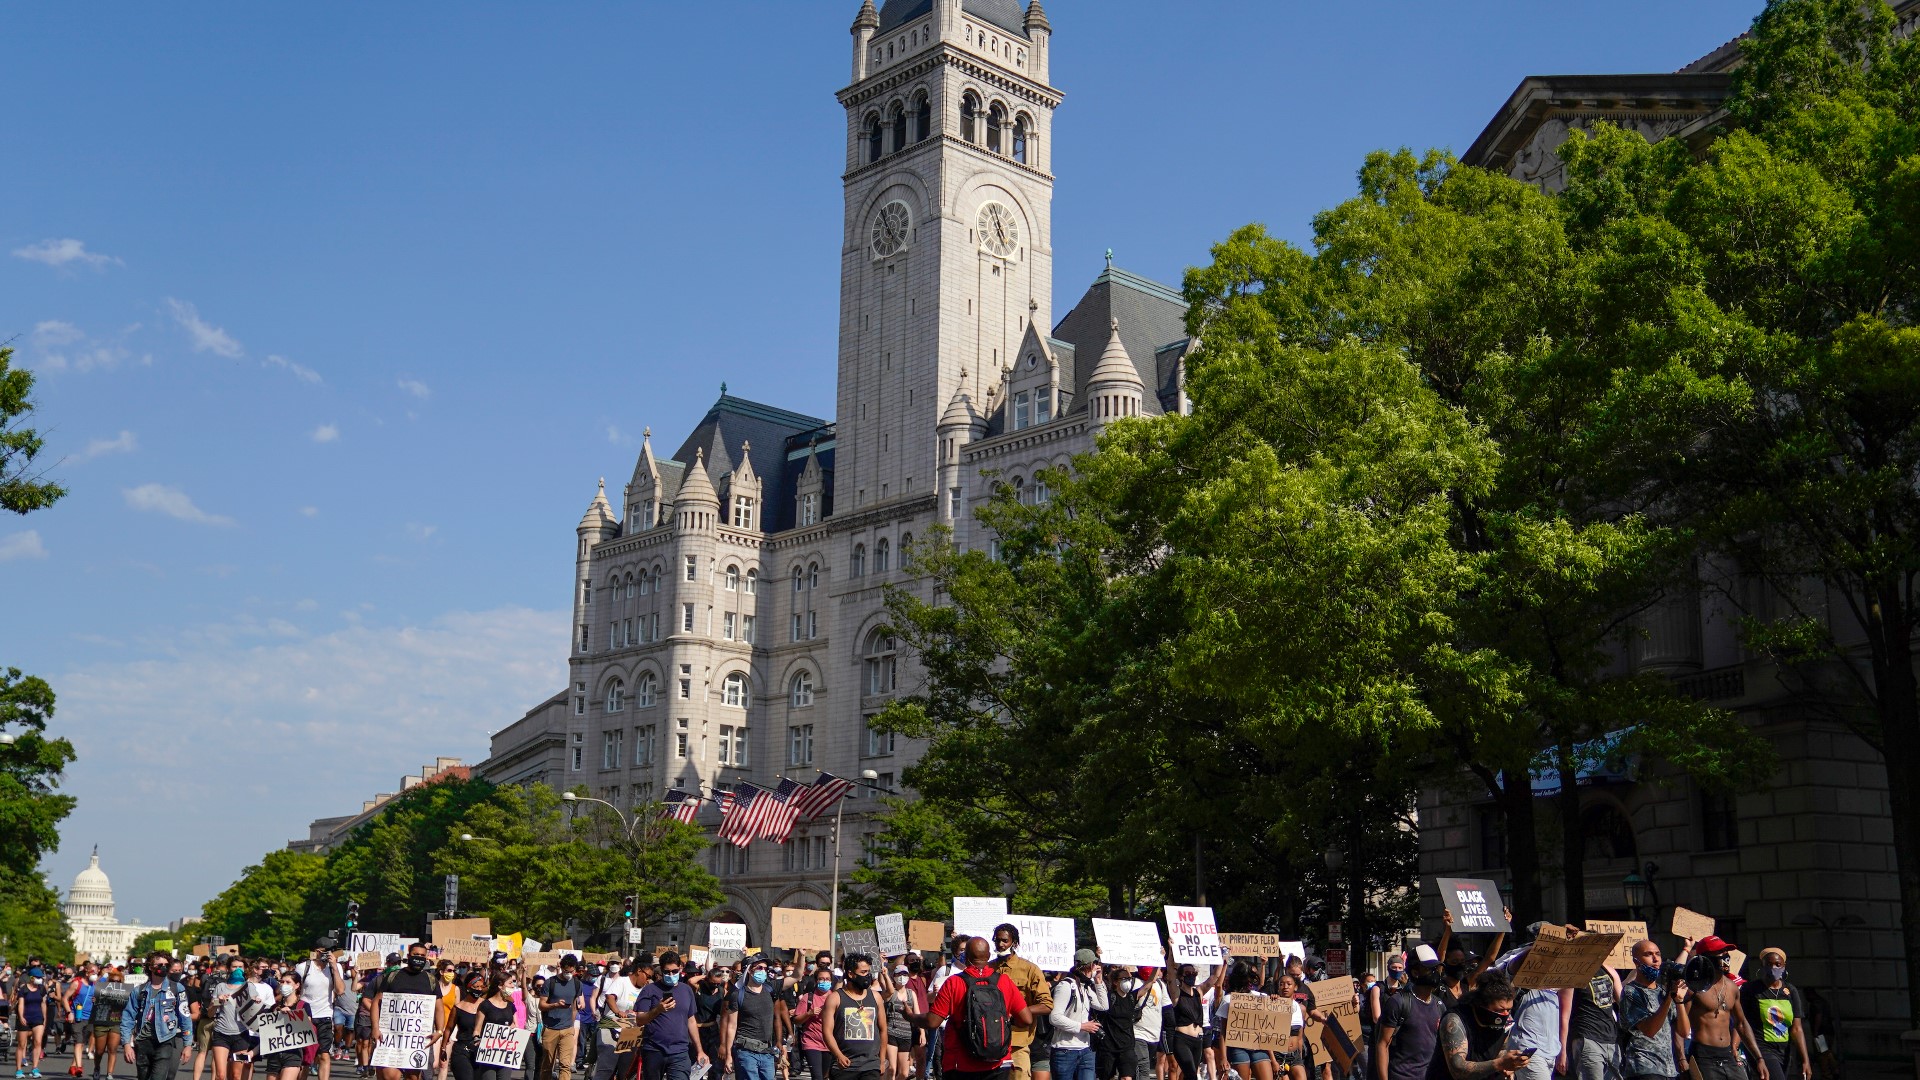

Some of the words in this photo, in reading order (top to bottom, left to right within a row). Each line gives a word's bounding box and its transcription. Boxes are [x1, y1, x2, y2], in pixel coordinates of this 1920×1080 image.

[1456, 890, 1486, 903] BLACK
[1461, 904, 1488, 915] LIVES
[1178, 911, 1194, 922] NO
[1460, 915, 1496, 927] MATTER
[712, 926, 742, 936] BLACK
[1020, 920, 1053, 938] HATE
[1172, 922, 1217, 934] JUSTICE
[1540, 928, 1560, 940] END
[1628, 926, 1645, 934] What
[353, 934, 376, 952] NO
[713, 938, 742, 948] LIVES
[844, 932, 877, 946] BLACK
[1184, 934, 1200, 945] NO
[1229, 934, 1259, 945] PARENTS
[1046, 941, 1068, 953] MAKE
[1178, 945, 1218, 957] PEACE
[1252, 946, 1259, 954] 4
[1262, 946, 1280, 954] THIS?
[710, 950, 741, 959] MATTER
[1524, 960, 1544, 970] NO
[1522, 976, 1538, 984] NO
[105, 982, 126, 992] ALL
[388, 1000, 424, 1014] BLACK
[260, 1012, 280, 1026] SAY
[390, 1018, 422, 1032] LIVES
[1230, 1010, 1276, 1030] MATTER
[276, 1022, 292, 1036] TO
[484, 1024, 518, 1042] BLACK
[268, 1029, 316, 1051] RACISM
[380, 1034, 425, 1050] MATTER
[1227, 1030, 1250, 1042] LIVES
[1252, 1031, 1286, 1047] BLACK
[485, 1038, 519, 1052] LIVES
[476, 1048, 521, 1066] MATTER
